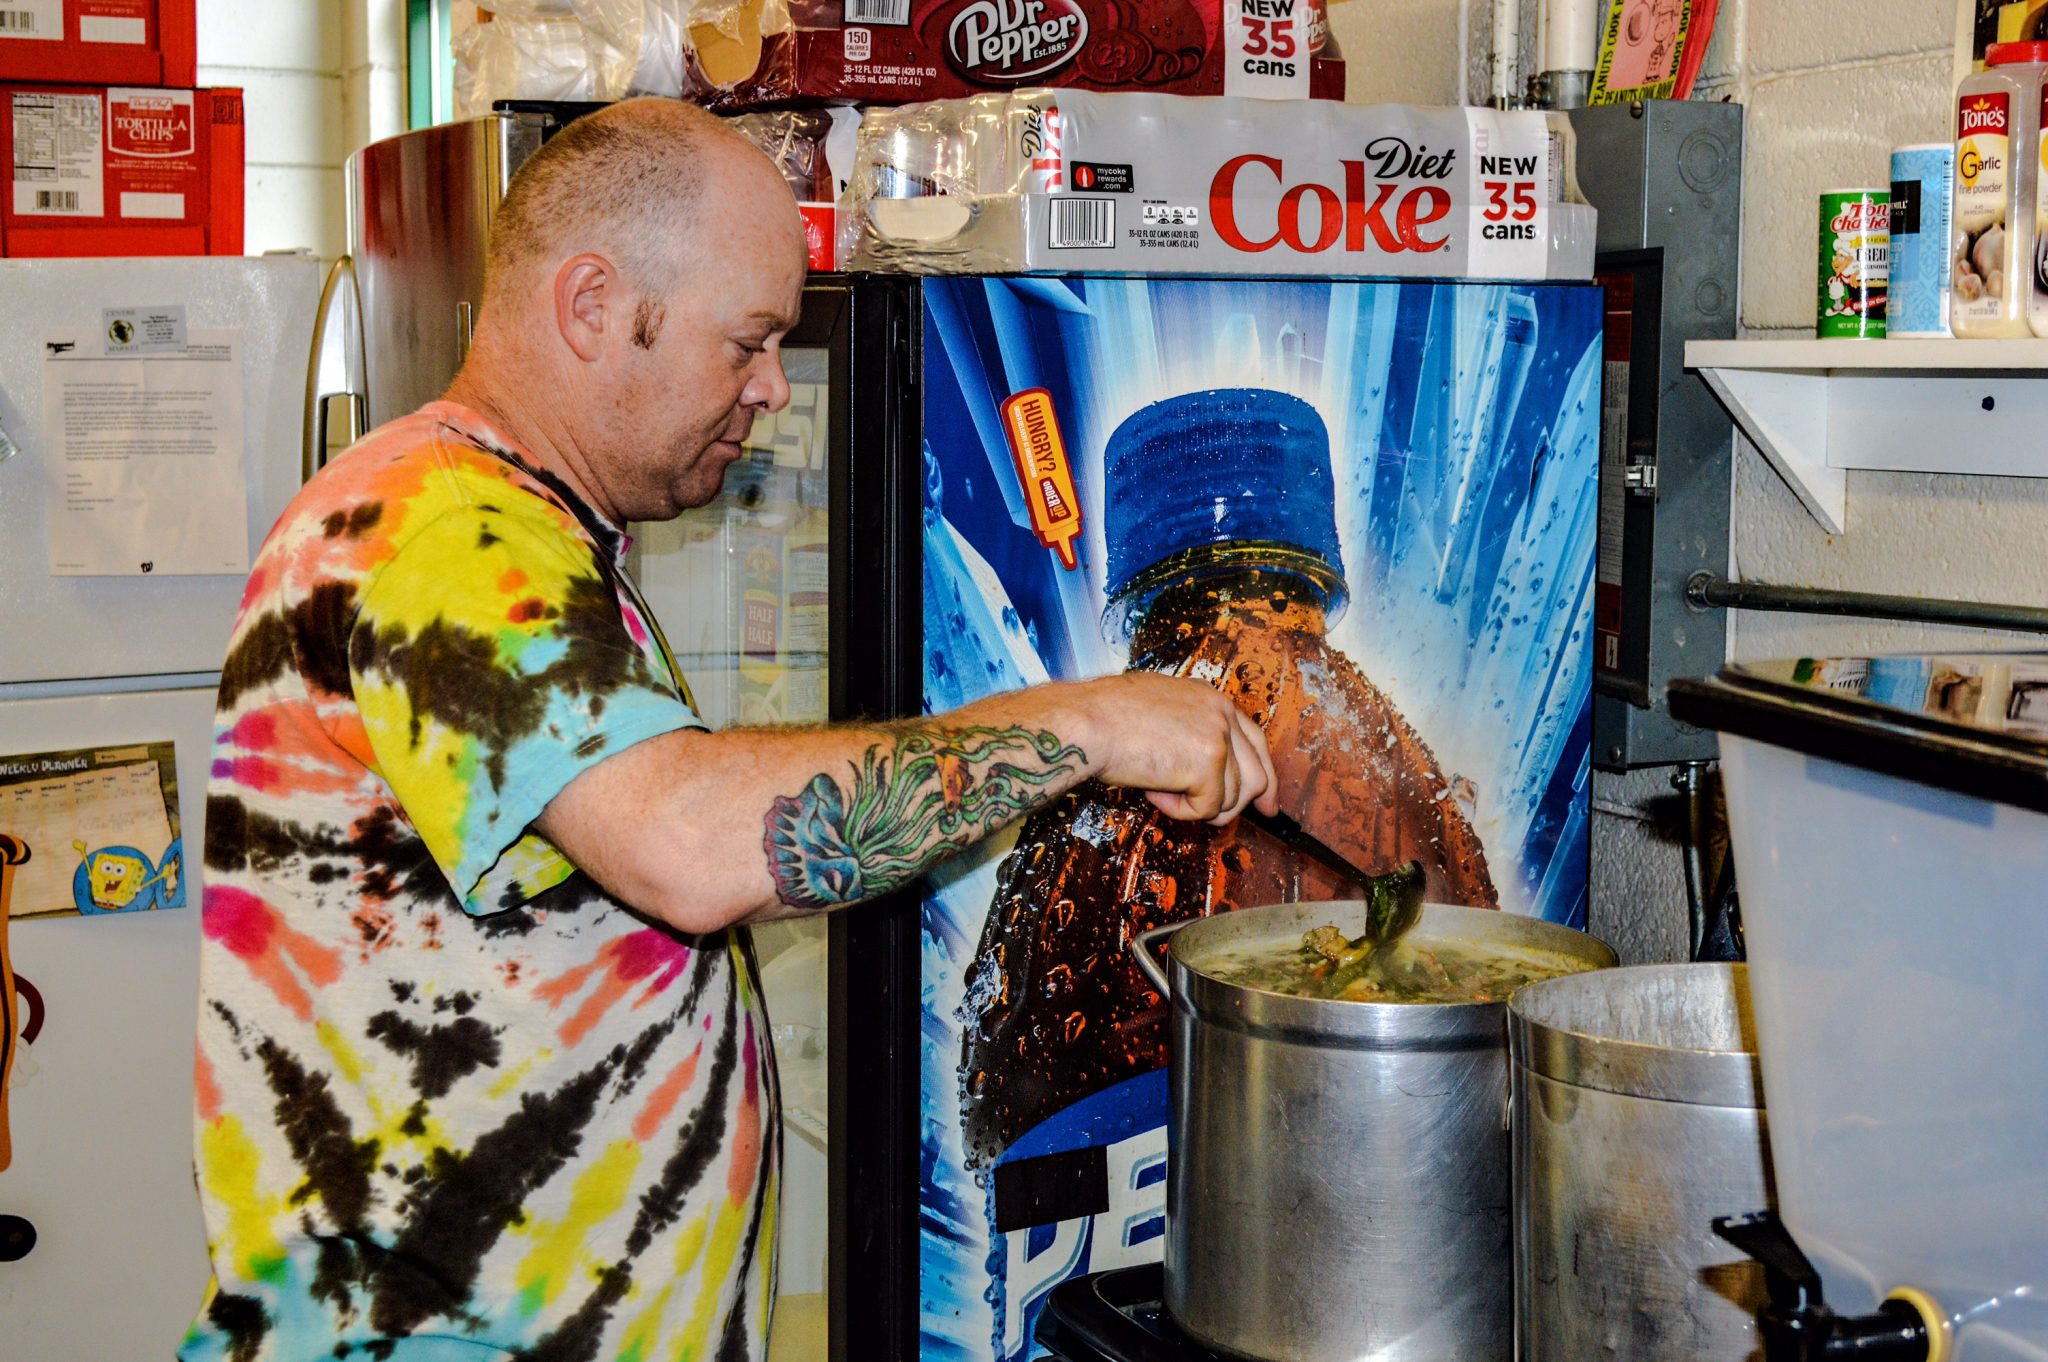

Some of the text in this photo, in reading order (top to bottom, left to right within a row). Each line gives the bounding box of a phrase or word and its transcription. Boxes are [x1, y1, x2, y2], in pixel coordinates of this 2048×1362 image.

[998, 0, 1044, 33] Dr
[1242, 0, 1295, 17] NEW
[848, 32, 868, 43] 150
[949, 1, 1080, 69] Pepper
[1242, 16, 1296, 59] 35
[844, 65, 936, 77] 35-12 FL OZ CANS (420 FL OZ)
[1243, 59, 1296, 77] cans
[844, 74, 866, 83] 35-355
[879, 76, 897, 84] CANS
[897, 77, 914, 86] (12.4
[914, 78, 921, 86] L)
[115, 116, 187, 131] TORTILLA
[1961, 106, 2005, 131] Tone's
[129, 129, 174, 141] CHIPS
[1021, 103, 1041, 158] Diet
[1364, 137, 1456, 179] Diet
[1481, 156, 1537, 175] NEW
[1961, 152, 2001, 179] Garlic
[1097, 167, 1126, 176] mycoke
[1097, 175, 1127, 183] rewards
[1973, 183, 2002, 196] powder
[1209, 153, 1452, 253] Coke
[1483, 182, 1536, 222] 35
[1850, 199, 1889, 218] Ton
[1143, 230, 1148, 238] FL
[1149, 230, 1156, 238] OZ
[1482, 224, 1536, 240] cans
[1140, 240, 1156, 248] 35-355
[1166, 240, 1179, 248] CANS
[1022, 399, 1057, 473] HUNGRY?
[749, 606, 773, 623] HALF
[748, 626, 774, 645] HALF
[42, 756, 88, 772] PLANNER
